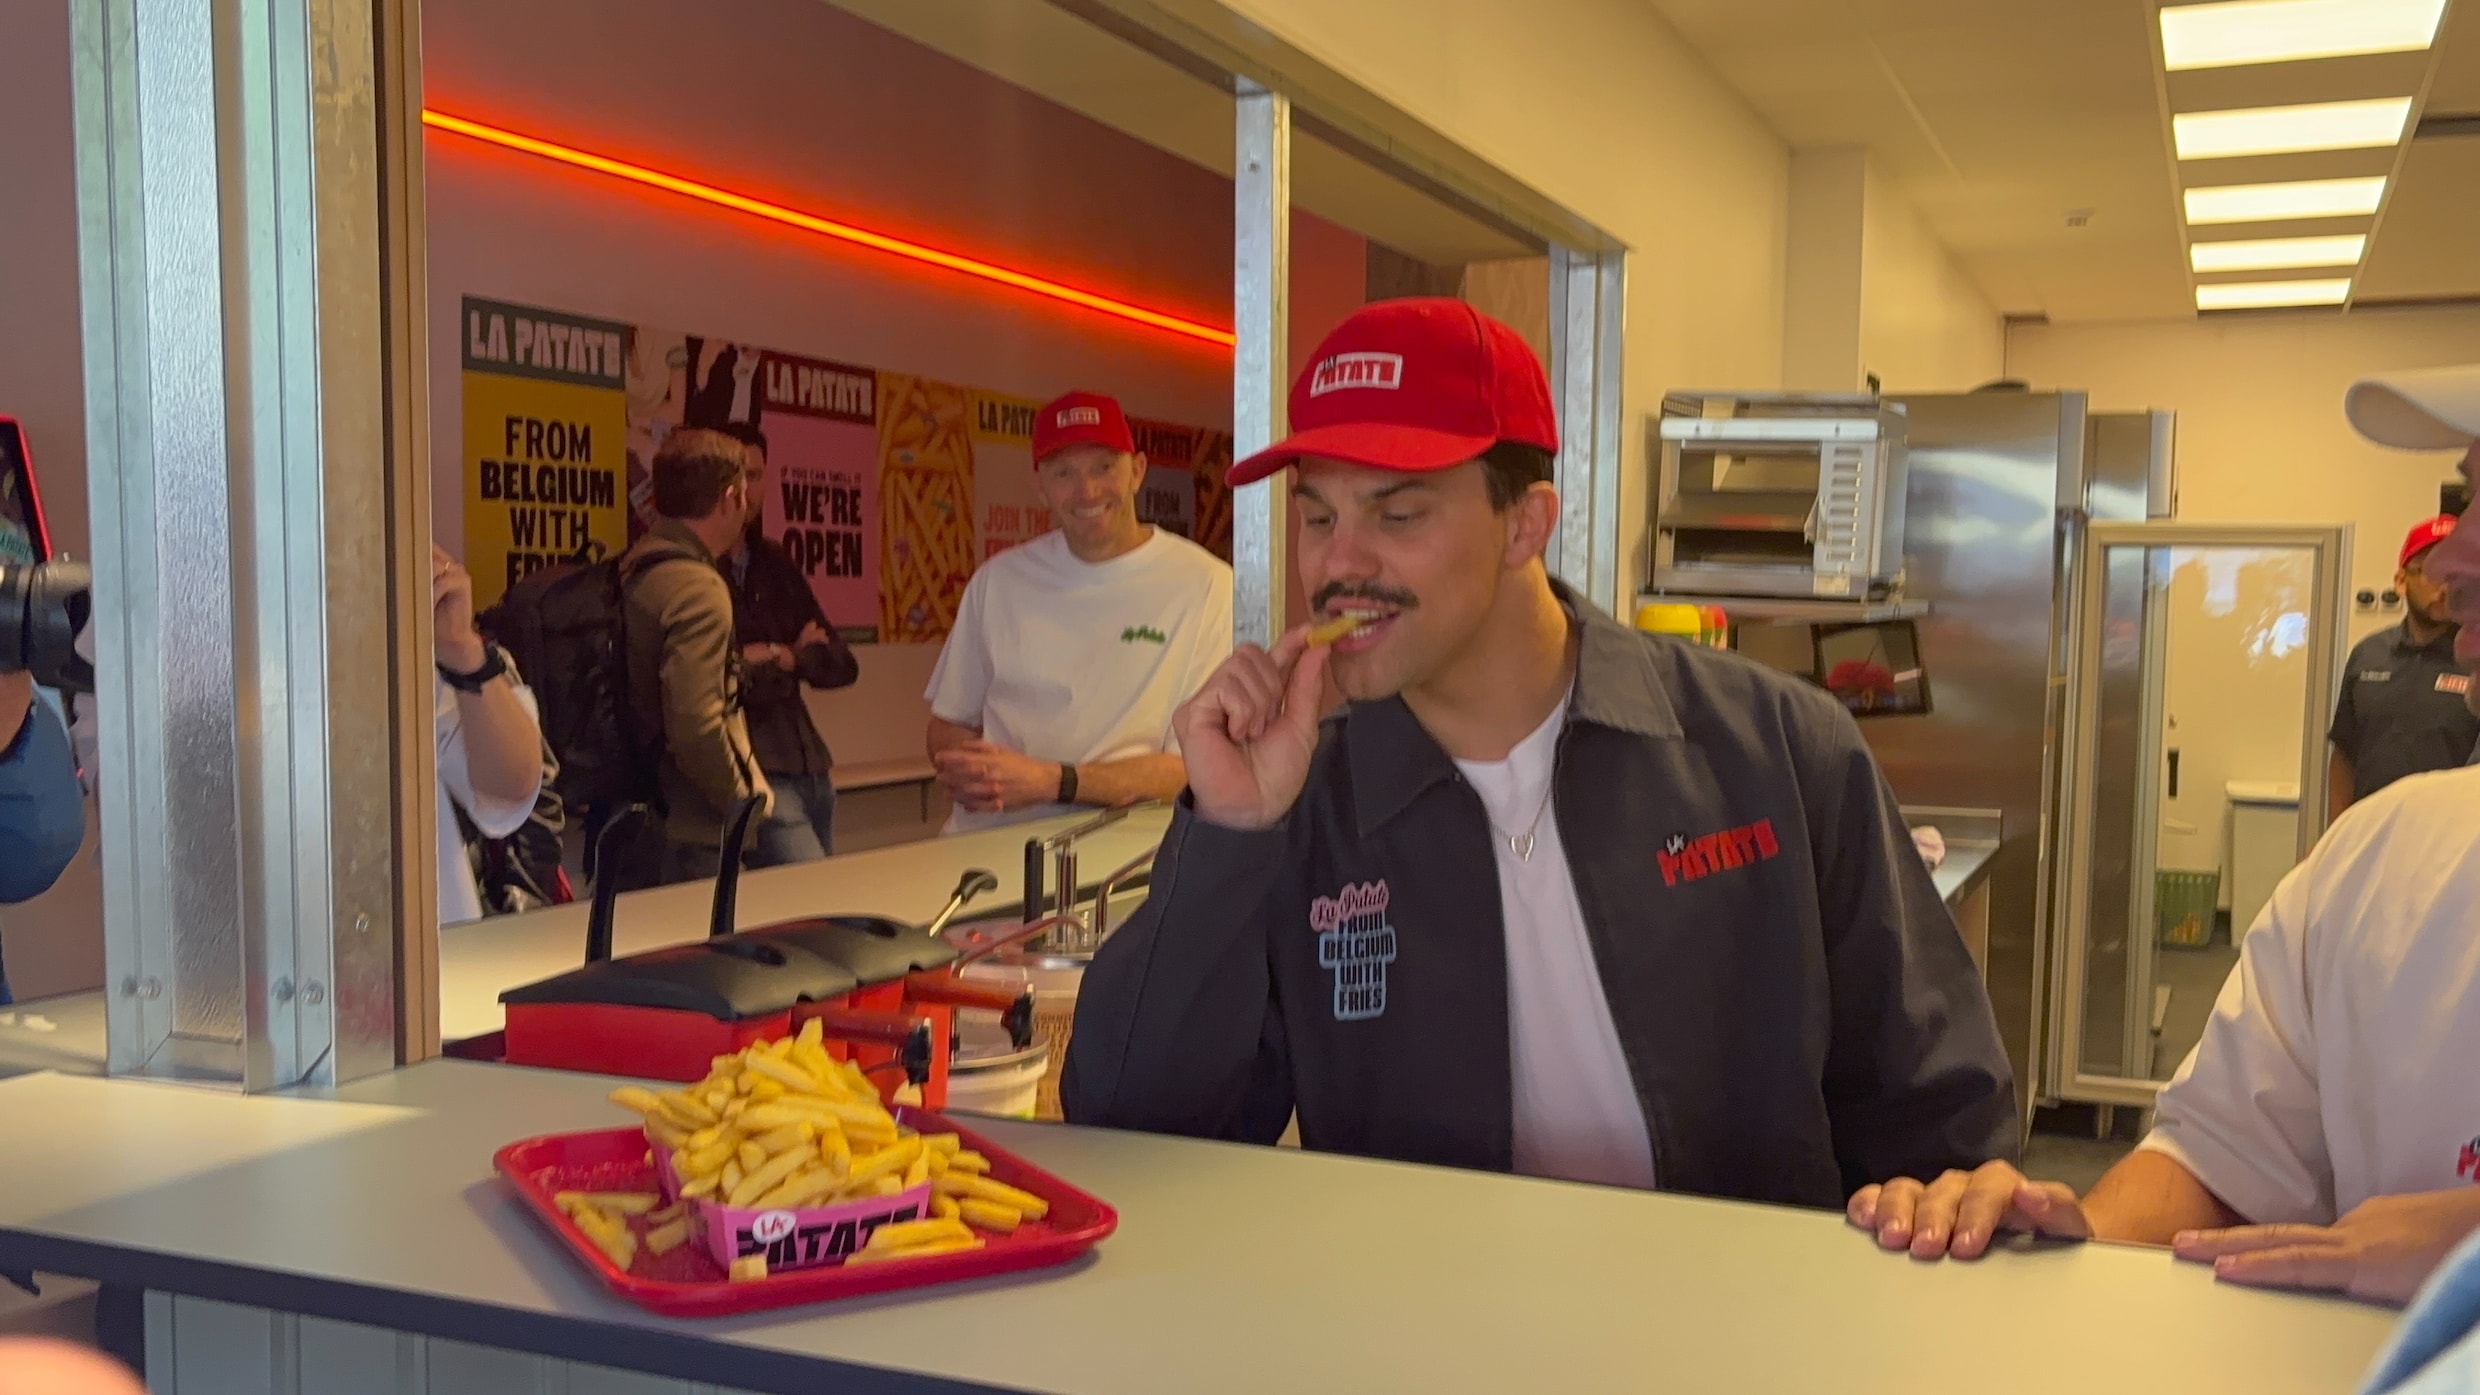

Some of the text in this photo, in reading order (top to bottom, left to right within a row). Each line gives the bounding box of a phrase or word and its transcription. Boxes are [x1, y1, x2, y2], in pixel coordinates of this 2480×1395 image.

[470, 308, 509, 363] LA
[767, 360, 795, 405] LA
[978, 400, 997, 431] LA
[505, 415, 591, 464] FROM
[480, 460, 615, 509] BELGIUM
[782, 482, 863, 526] WE'RE
[510, 507, 590, 550] WITH
[983, 502, 1021, 533] JOIN
[782, 526, 863, 578] OPEN
[1323, 933, 1395, 961] BELGIUM
[1338, 987, 1384, 1013] FRIES
